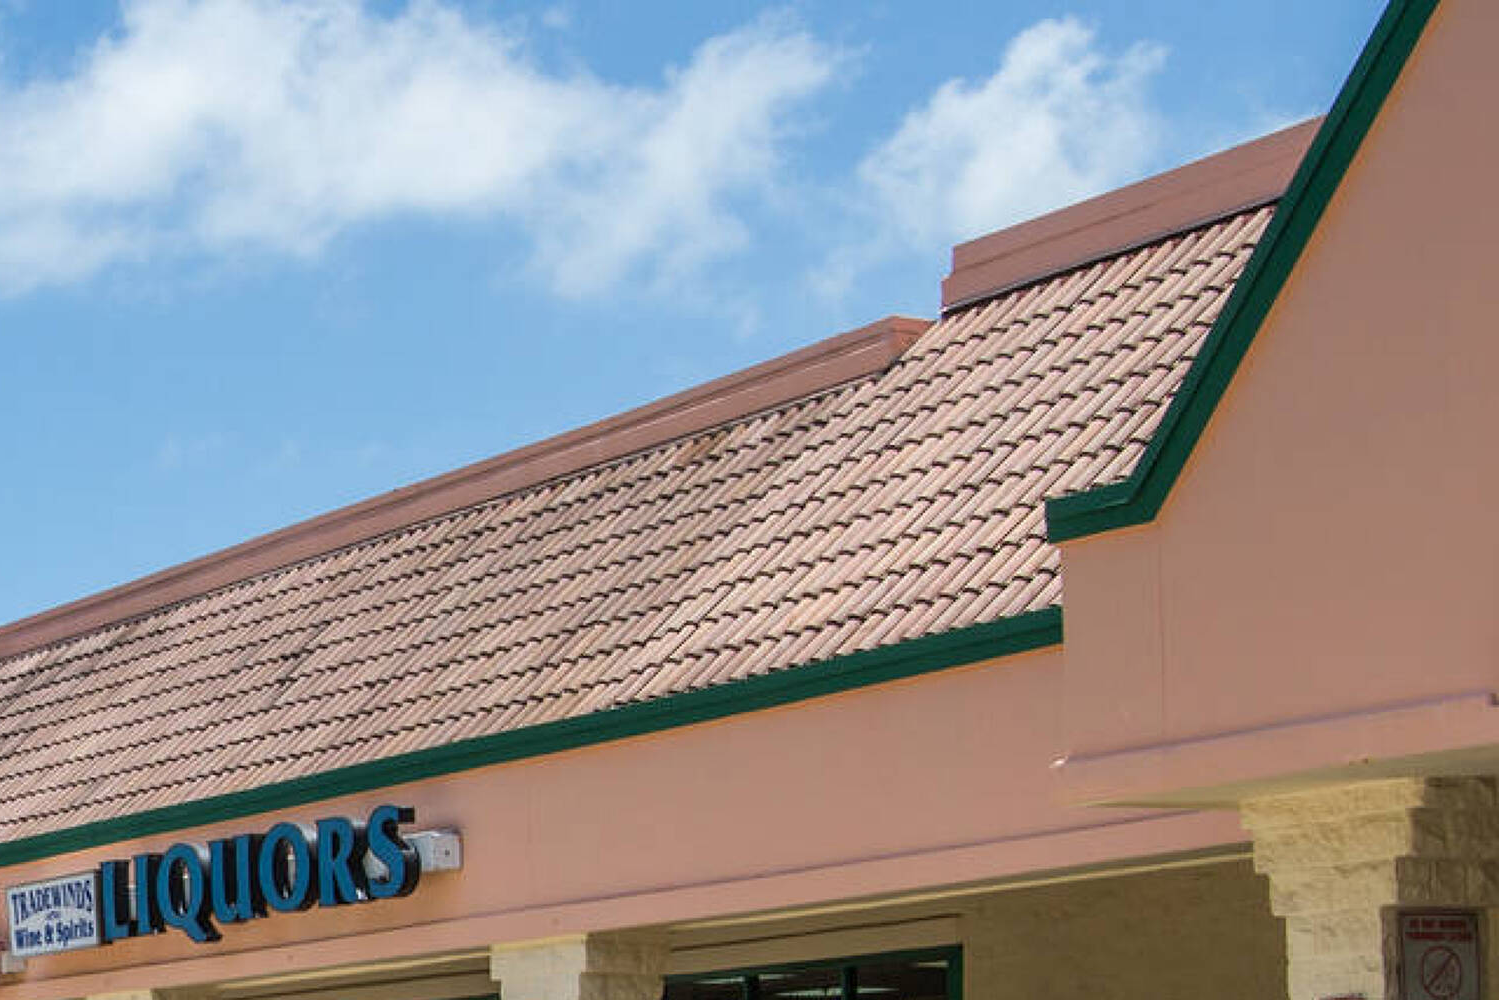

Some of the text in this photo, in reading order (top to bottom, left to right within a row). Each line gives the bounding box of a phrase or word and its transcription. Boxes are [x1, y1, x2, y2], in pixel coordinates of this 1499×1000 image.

[101, 804, 417, 943] LIQUORS
[12, 880, 93, 925] TRADEWINDS
[15, 927, 42, 948] Wine
[56, 917, 94, 947] Spirits
